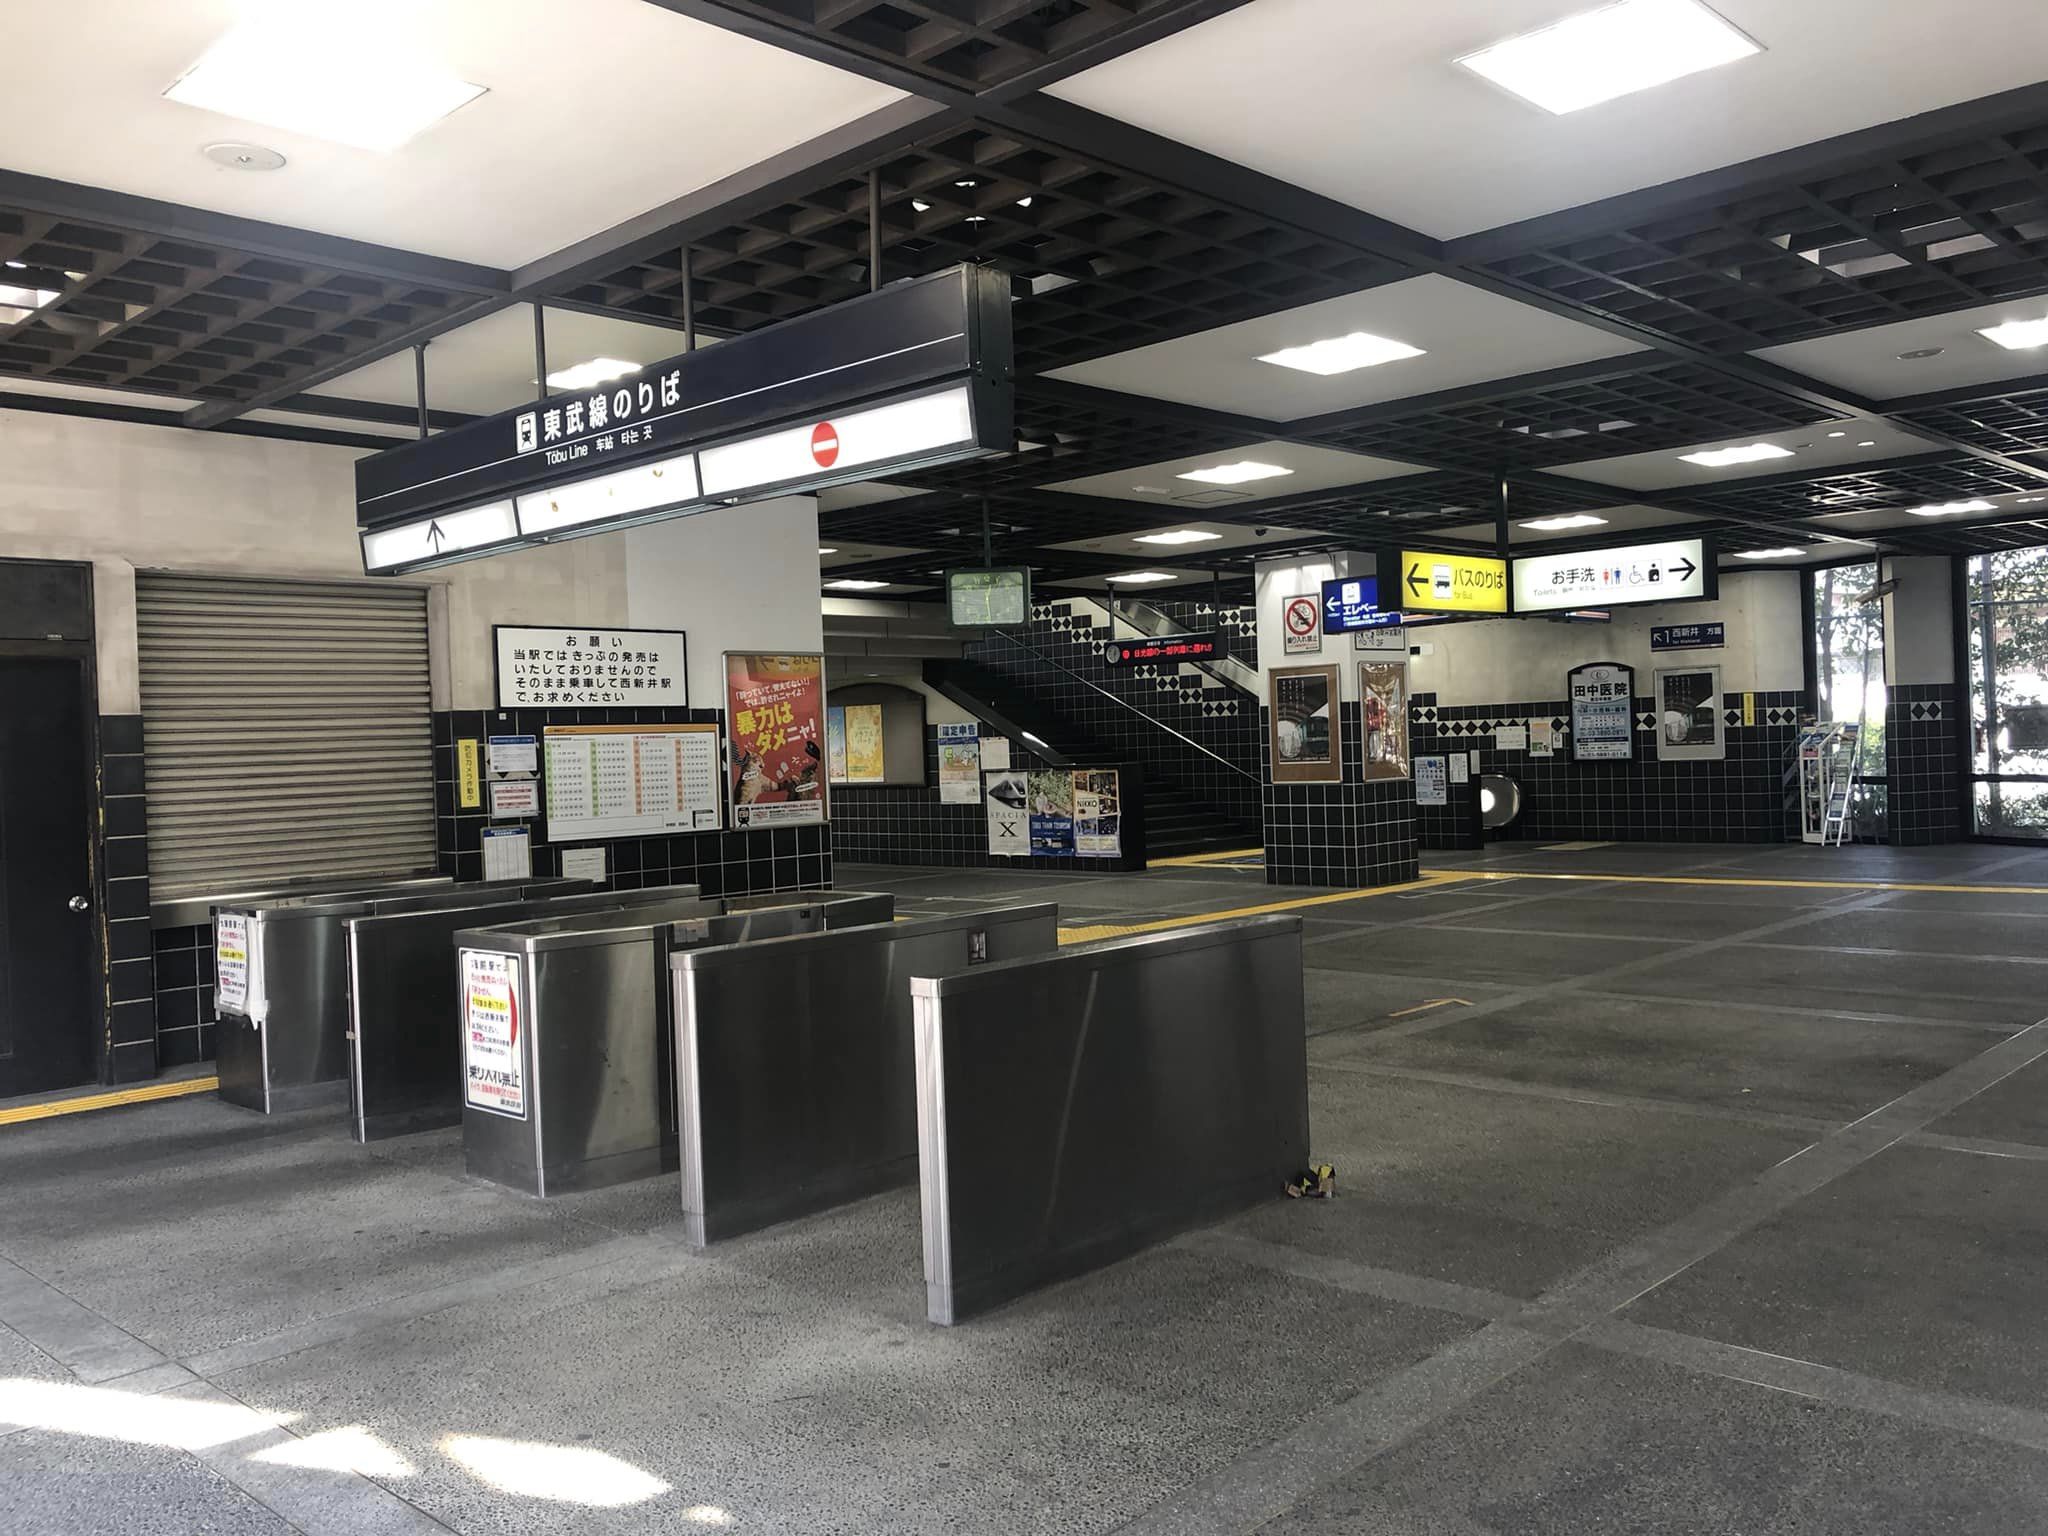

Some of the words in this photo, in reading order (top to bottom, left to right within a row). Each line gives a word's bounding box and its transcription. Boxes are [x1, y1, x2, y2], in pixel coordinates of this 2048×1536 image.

[543, 370, 680, 442] 東武線のりば
[569, 443, 588, 460] Line
[1454, 568, 1504, 589] バスのりば
[1551, 567, 1595, 585] お手洗
[566, 636, 623, 648] お願い
[514, 649, 659, 663] 当駅ではきっぷの発売は
[514, 664, 656, 676] いたしておりませんので
[515, 677, 672, 689] そのまま乗車して西新井駅
[1574, 682, 1628, 697] 田中医院
[736, 701, 794, 736] 暴力は
[998, 822, 1018, 837] X
